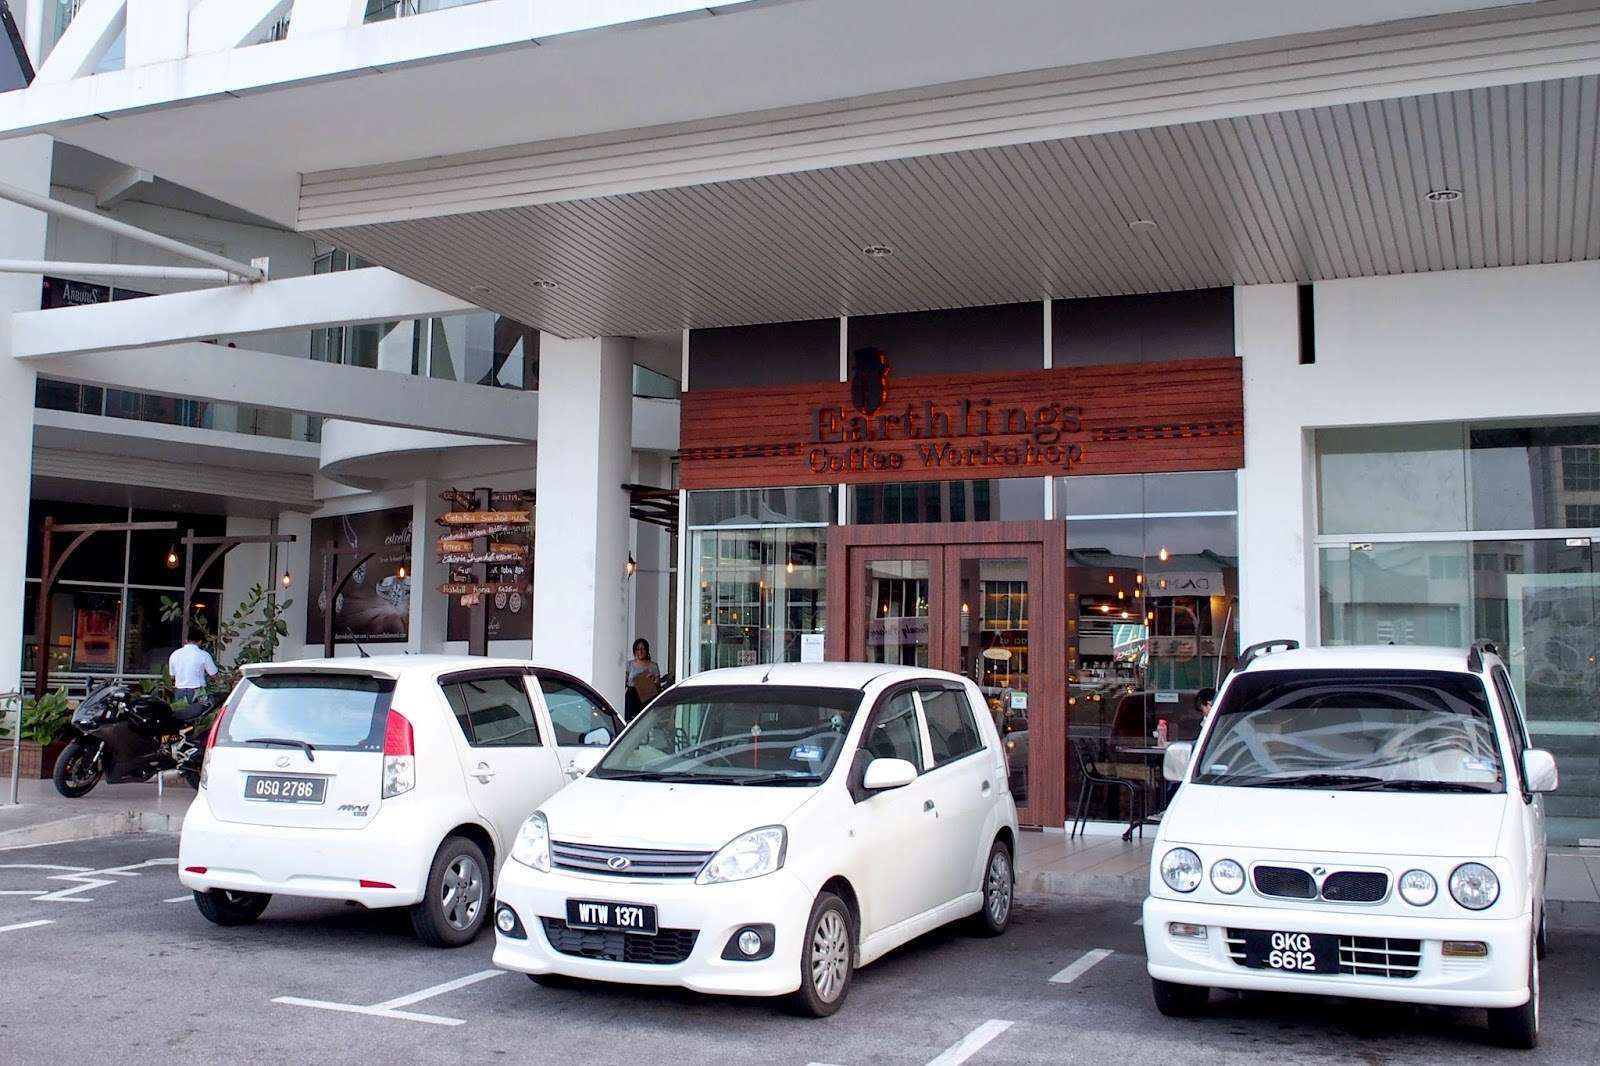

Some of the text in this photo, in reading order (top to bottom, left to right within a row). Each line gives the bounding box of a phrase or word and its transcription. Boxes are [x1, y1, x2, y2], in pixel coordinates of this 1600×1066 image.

[810, 398, 1083, 445] Earthlings
[805, 439, 1083, 473] Coffee Workshop
[256, 780, 313, 797] QSQ 2786
[579, 903, 643, 928] WTW 1371
[1271, 932, 1311, 951] QKQ
[1269, 950, 1316, 970] 6612
